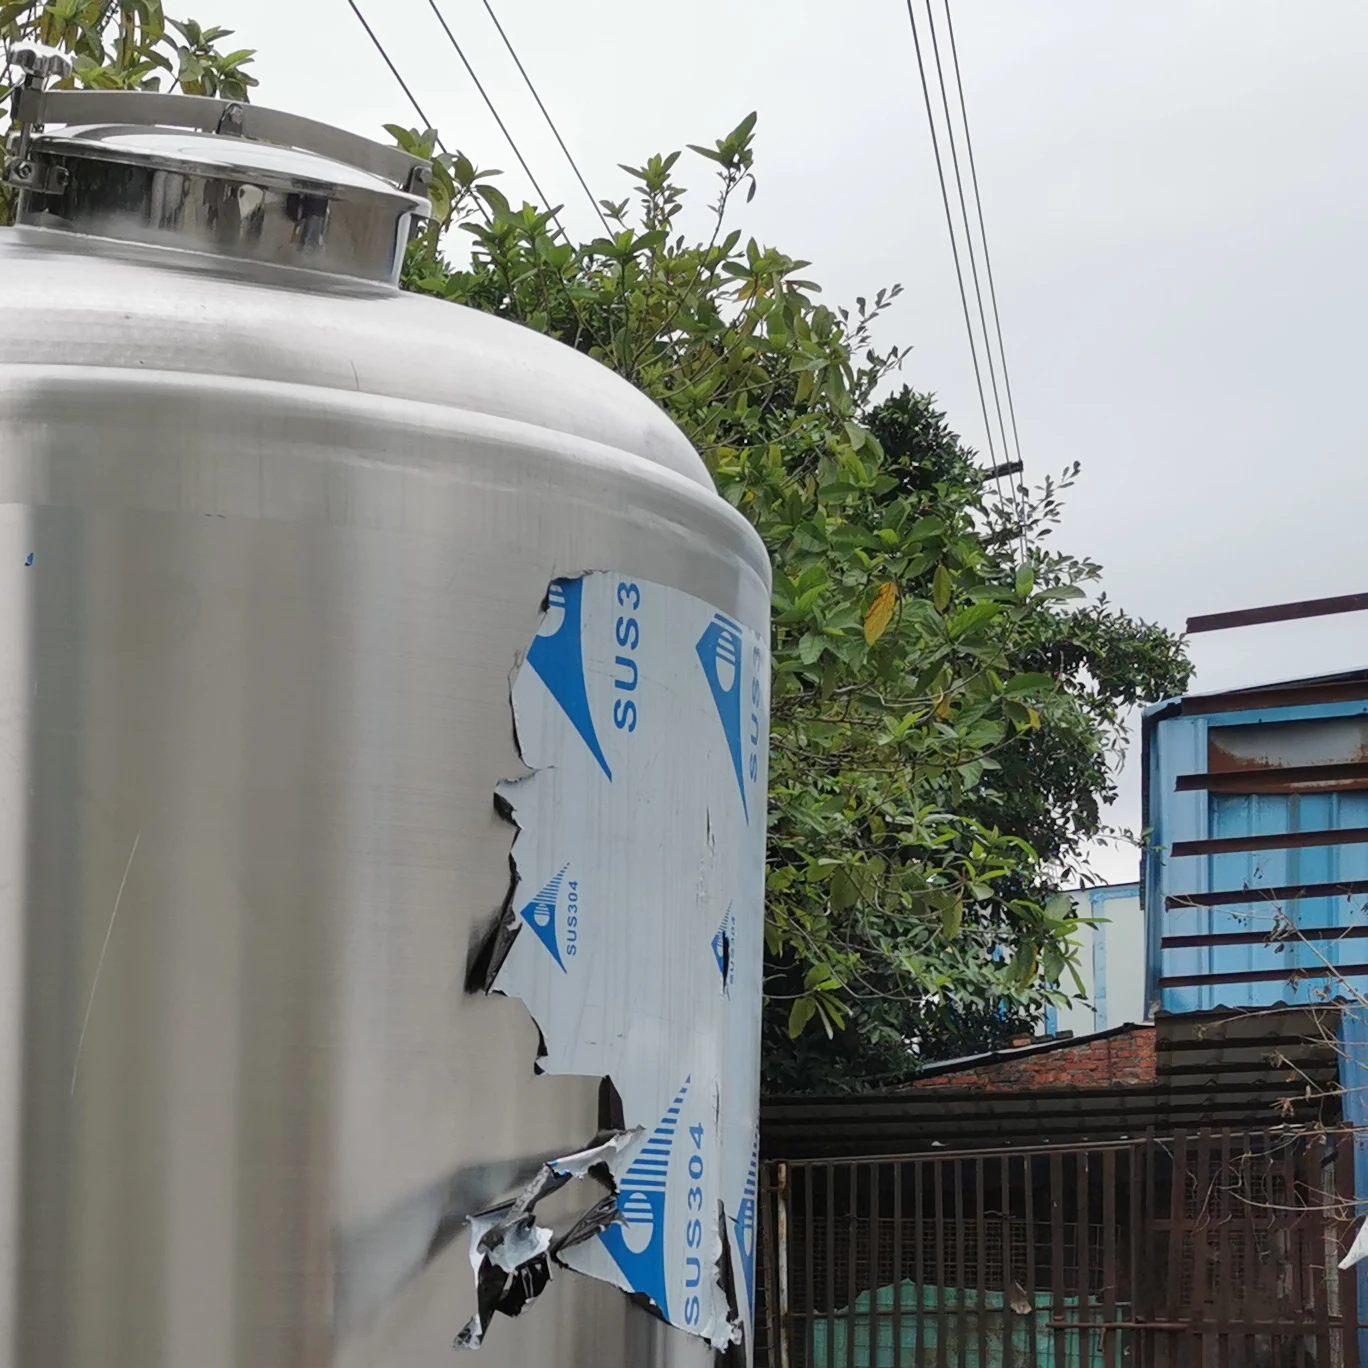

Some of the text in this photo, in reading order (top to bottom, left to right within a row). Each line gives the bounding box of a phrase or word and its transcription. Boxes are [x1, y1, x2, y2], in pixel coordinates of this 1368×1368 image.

[613, 581, 641, 733] SUS3
[566, 880, 579, 956] SUS304
[684, 1121, 705, 1327] SUS304
